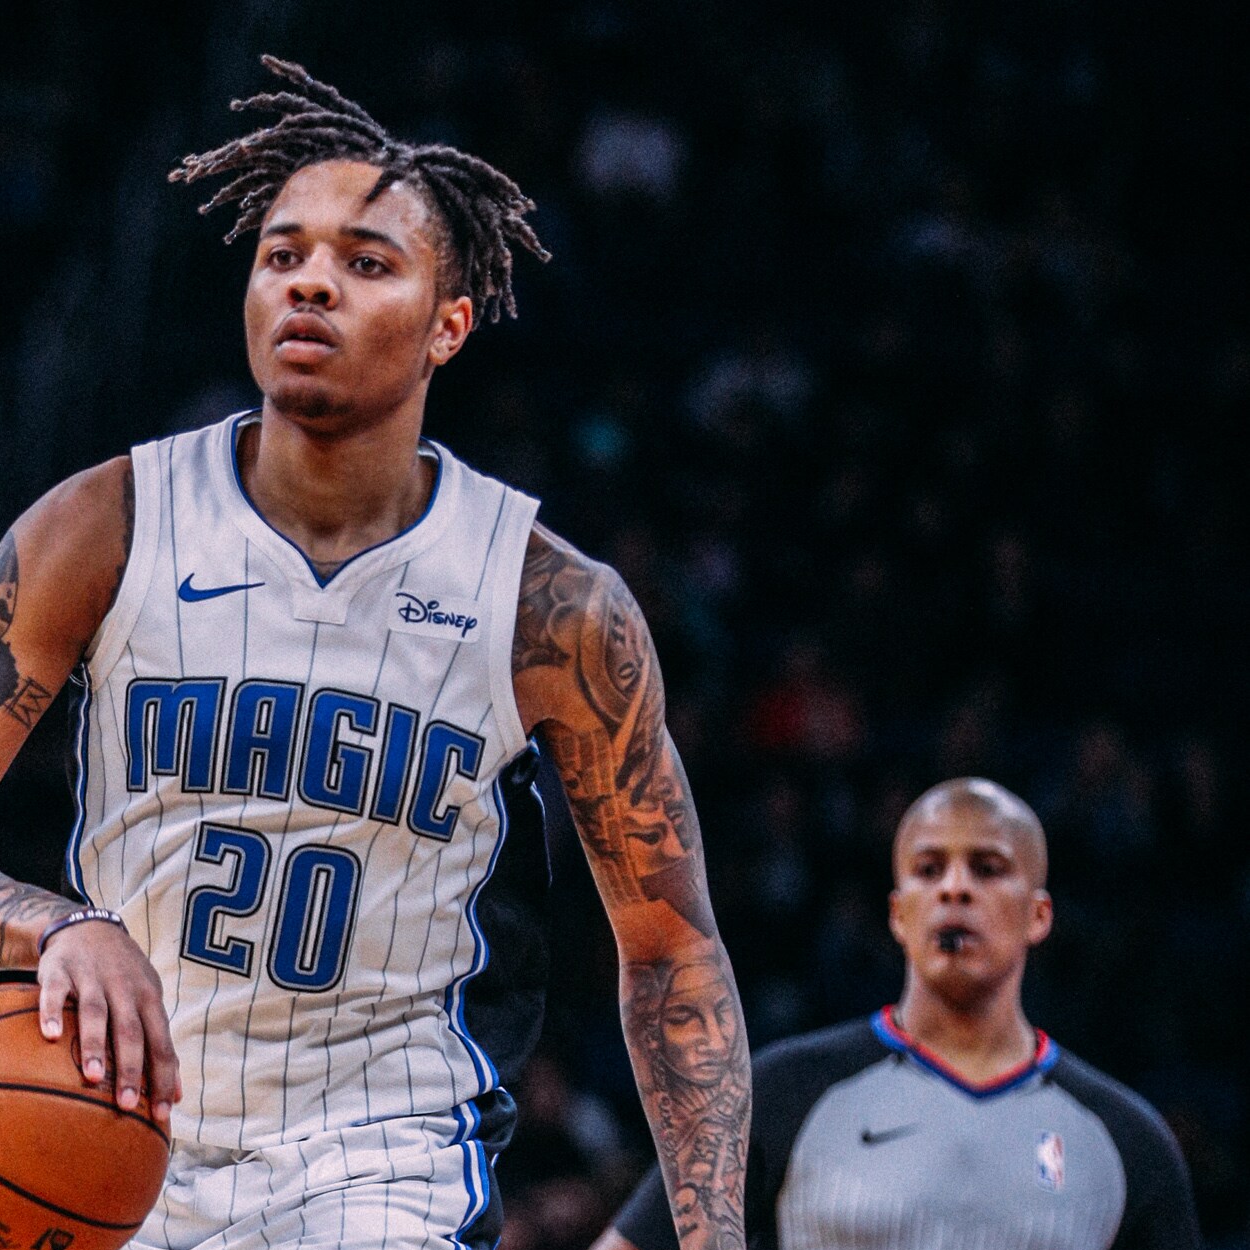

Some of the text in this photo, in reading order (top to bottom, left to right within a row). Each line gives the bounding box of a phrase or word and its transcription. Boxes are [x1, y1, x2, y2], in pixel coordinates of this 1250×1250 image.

[395, 592, 478, 638] Disney
[126, 676, 486, 842] MAGIC
[180, 822, 361, 993] 20
